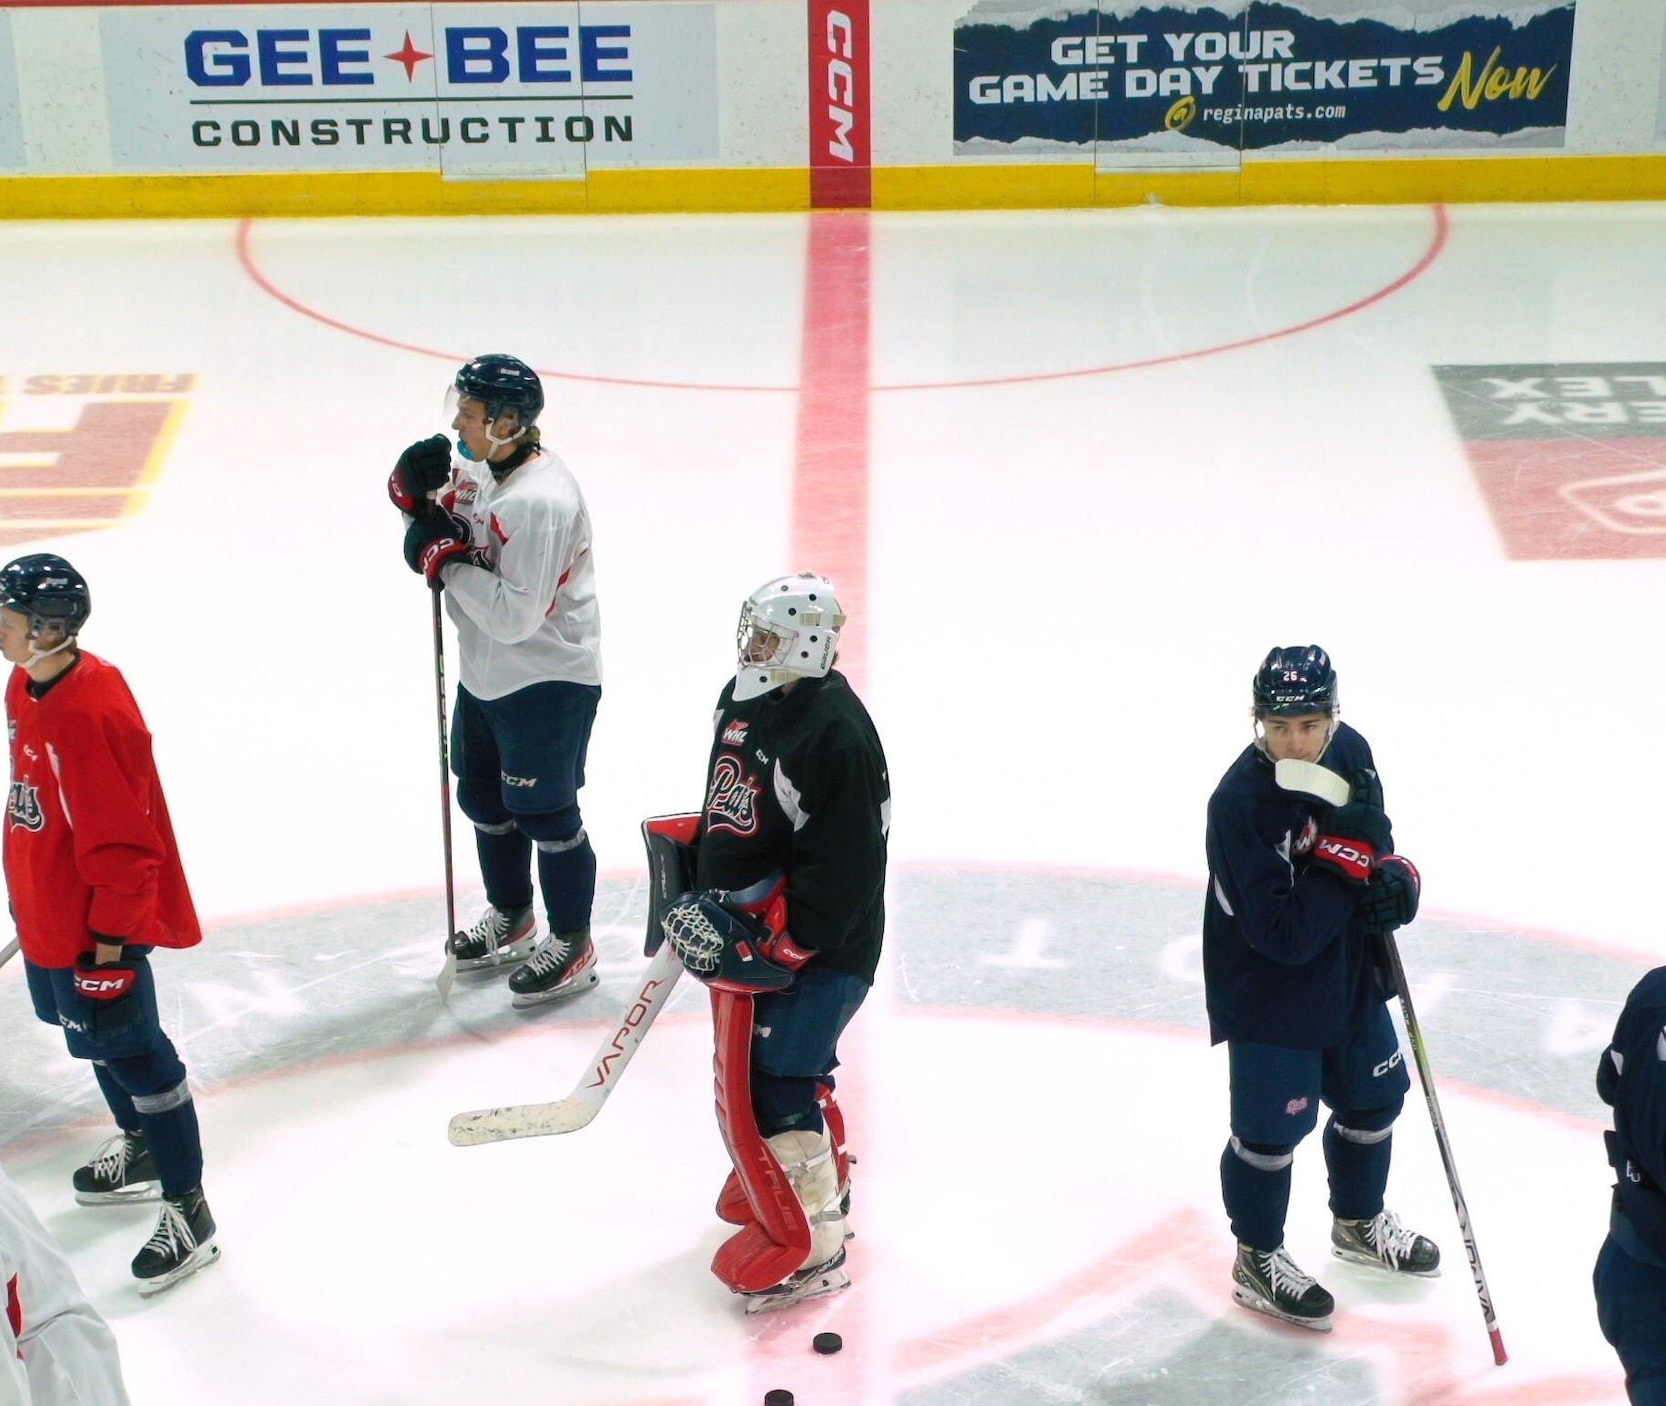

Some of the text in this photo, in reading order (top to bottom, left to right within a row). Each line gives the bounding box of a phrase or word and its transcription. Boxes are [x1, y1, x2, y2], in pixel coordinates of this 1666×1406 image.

[184, 24, 633, 87] GEE BEE
[968, 47, 1558, 112] GAME DAY TICKETS Now
[1051, 30, 1294, 66] GET YOUR
[824, 9, 855, 164] CCM
[1202, 101, 1347, 124] reginapats.com
[191, 115, 635, 148] CONSTRUCTION
[1282, 671, 1298, 682] 26
[584, 977, 668, 1089] VAPOR
[757, 1146, 800, 1232] TRUE
